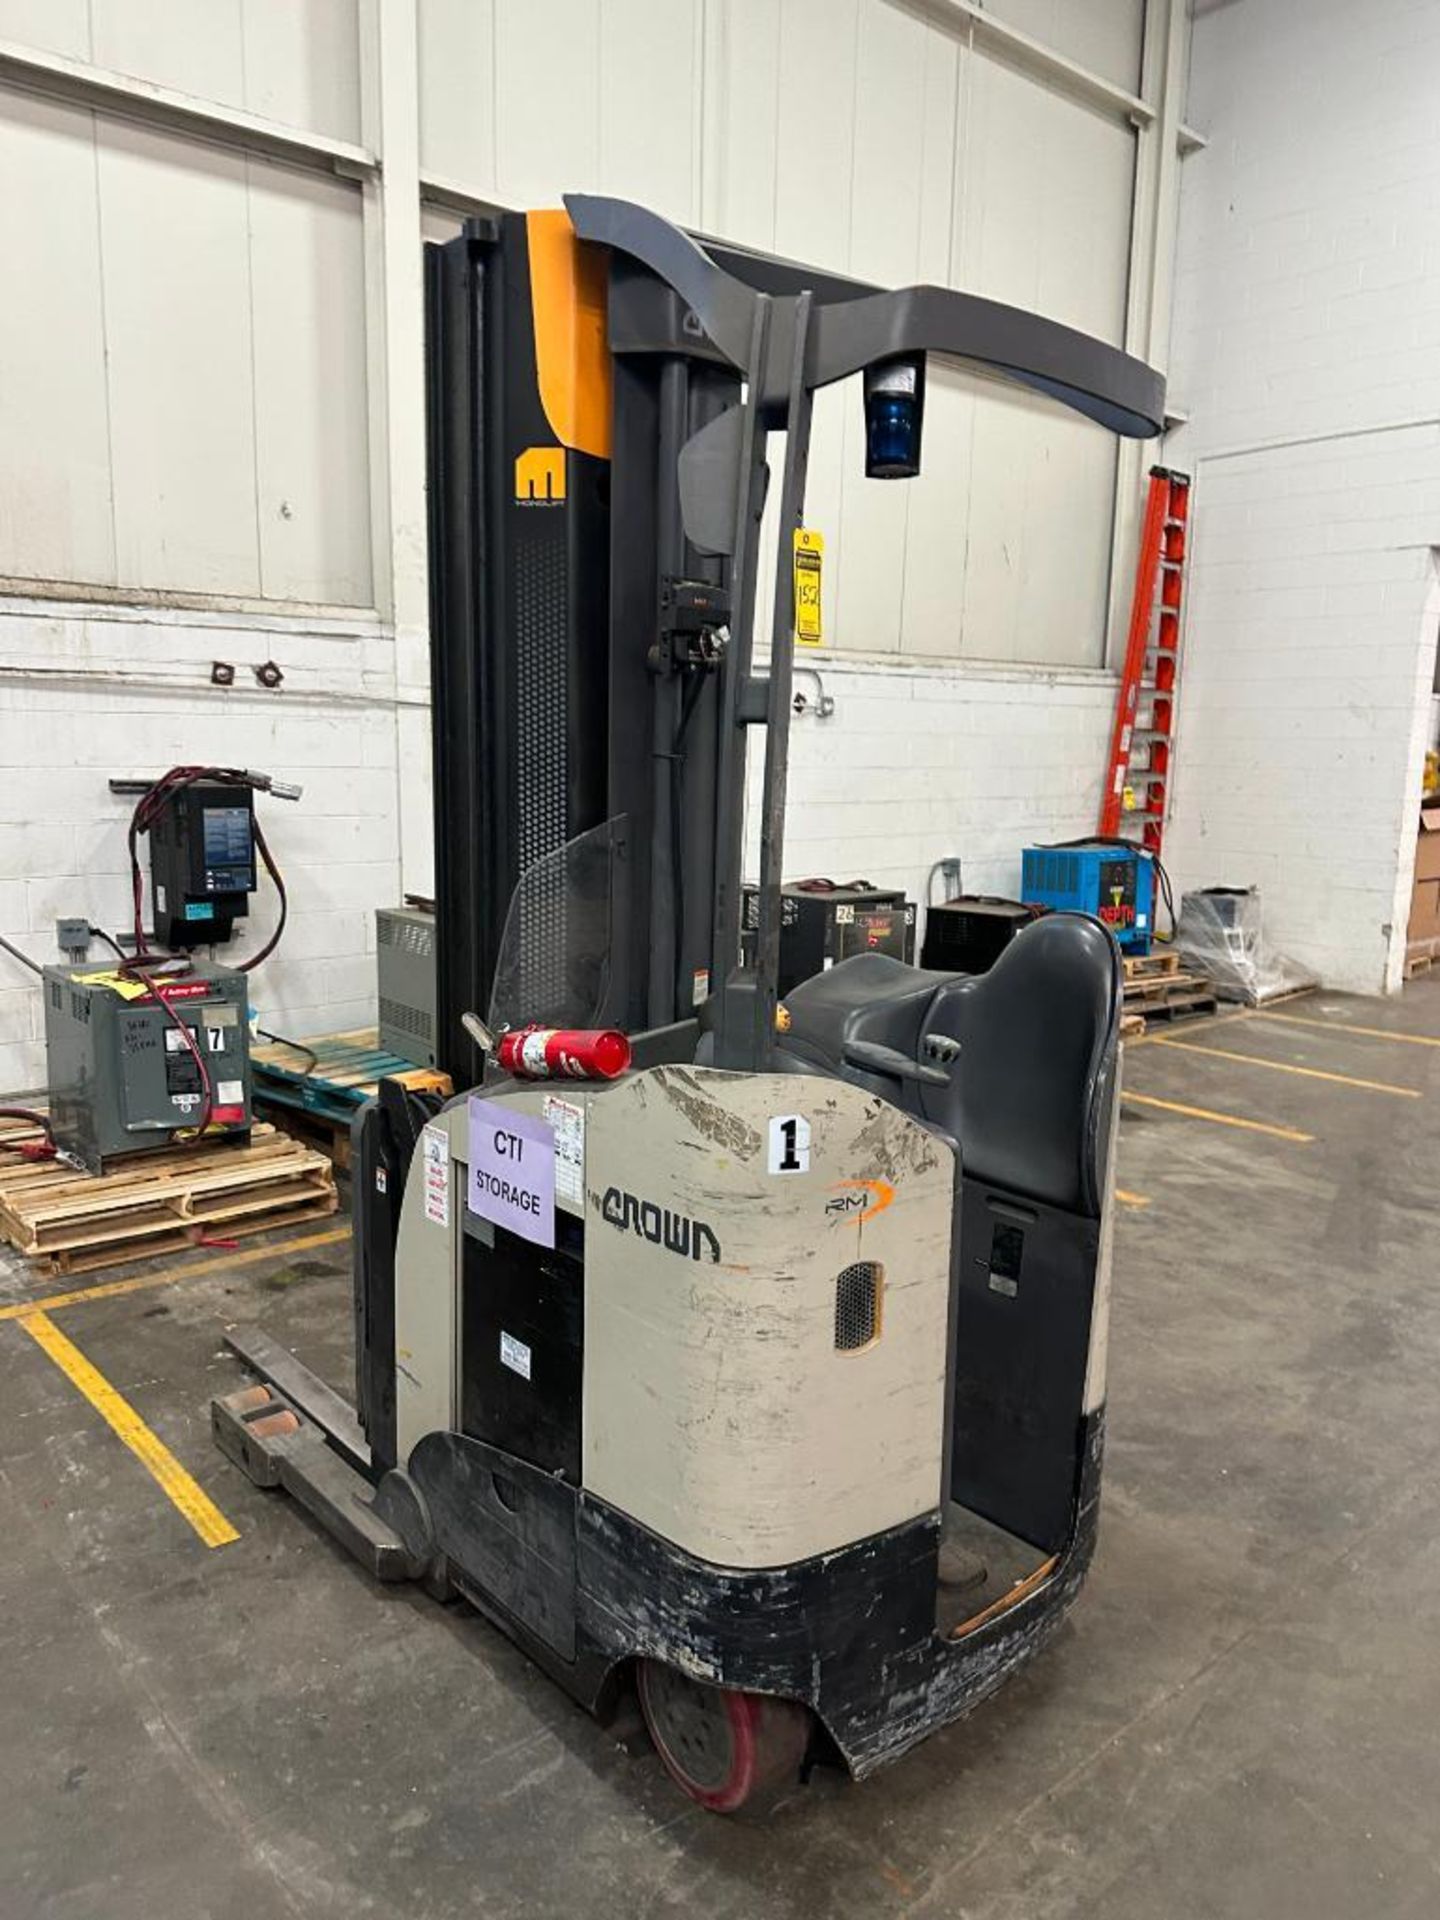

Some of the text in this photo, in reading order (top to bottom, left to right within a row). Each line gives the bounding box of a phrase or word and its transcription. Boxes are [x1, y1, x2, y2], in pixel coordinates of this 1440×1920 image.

[209, 1028, 220, 1050] 7
[493, 1130, 523, 1162] CTI
[779, 1119, 801, 1170] 1
[476, 1169, 541, 1217] STORAGE
[824, 1193, 868, 1215] RM
[602, 1186, 722, 1264] CROWN
